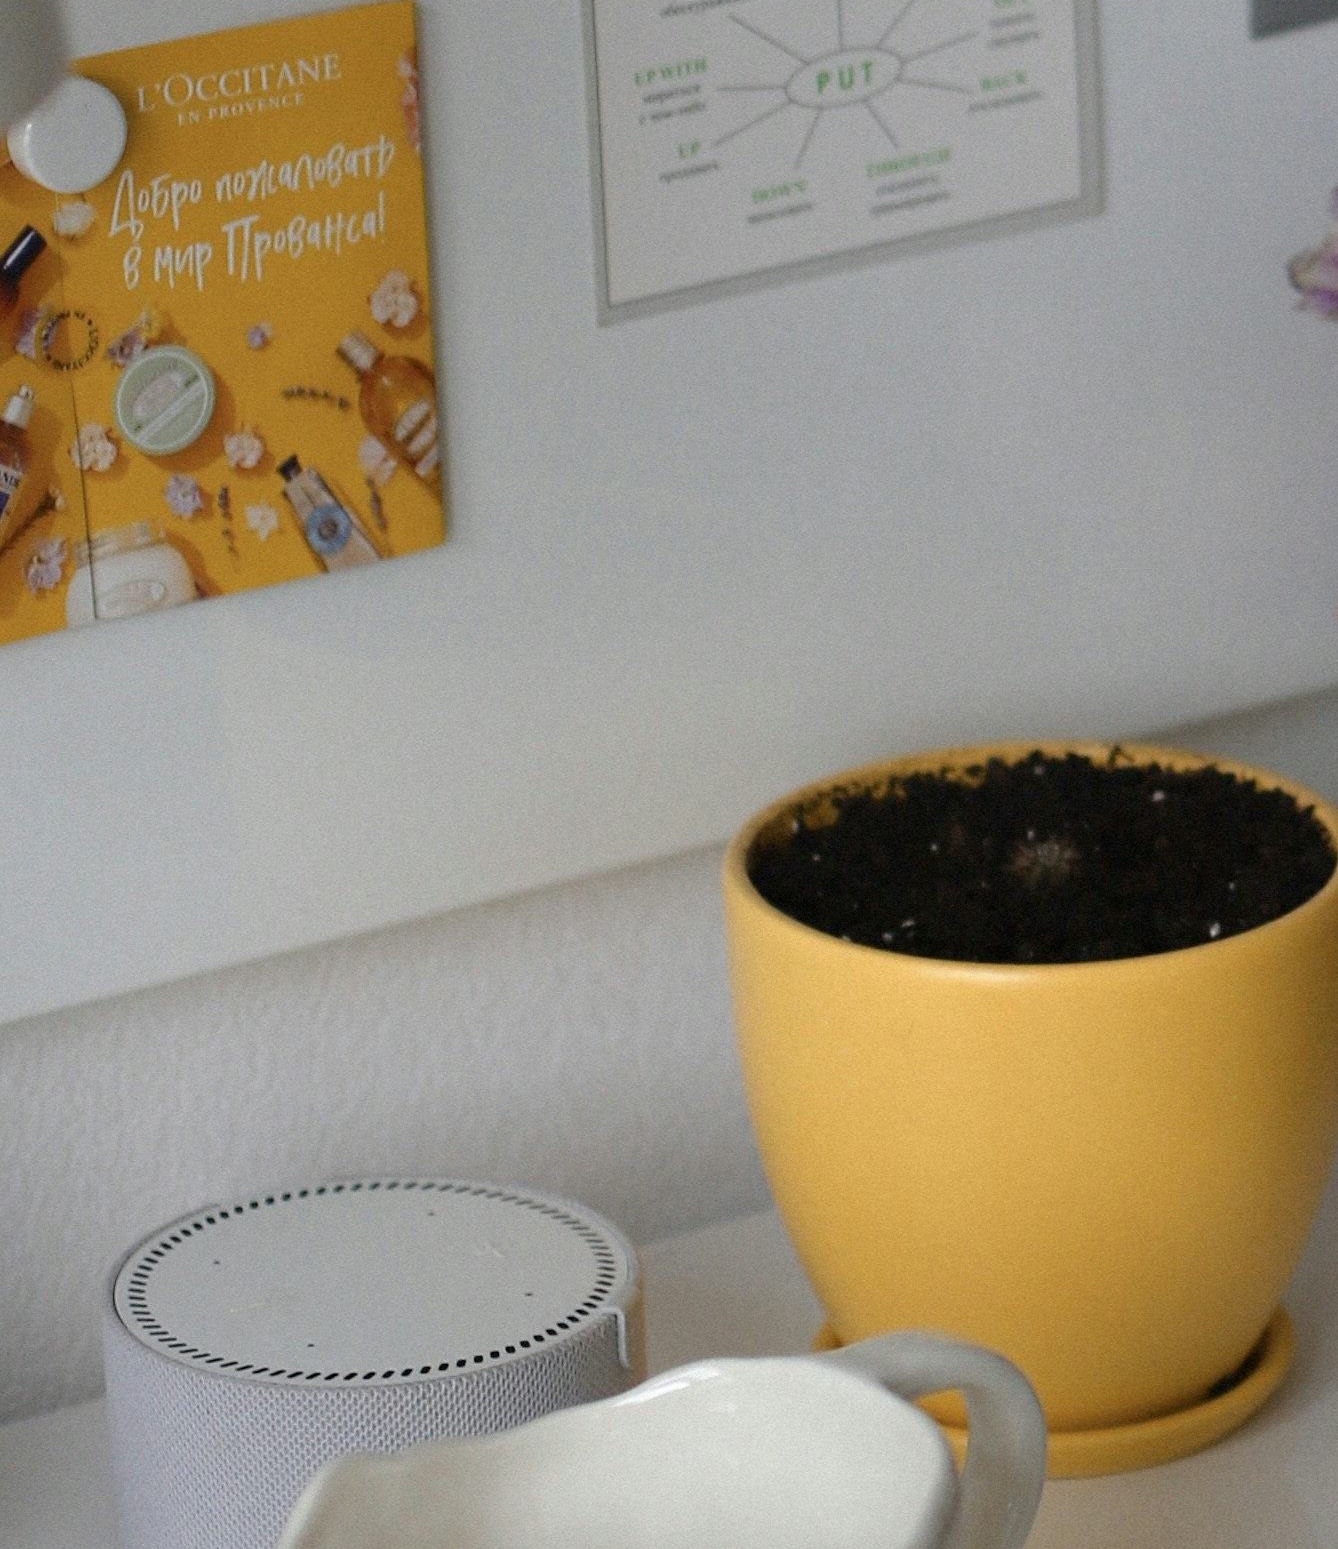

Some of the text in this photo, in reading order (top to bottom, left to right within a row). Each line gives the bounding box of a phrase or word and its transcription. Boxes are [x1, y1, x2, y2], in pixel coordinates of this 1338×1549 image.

[137, 52, 342, 114] L'OCCITANE
[815, 57, 875, 96] PUT
[177, 92, 305, 128] EN PROVENCE
[108, 133, 396, 243] Добро пожаловать
[122, 190, 386, 293] в мир Прованса!
